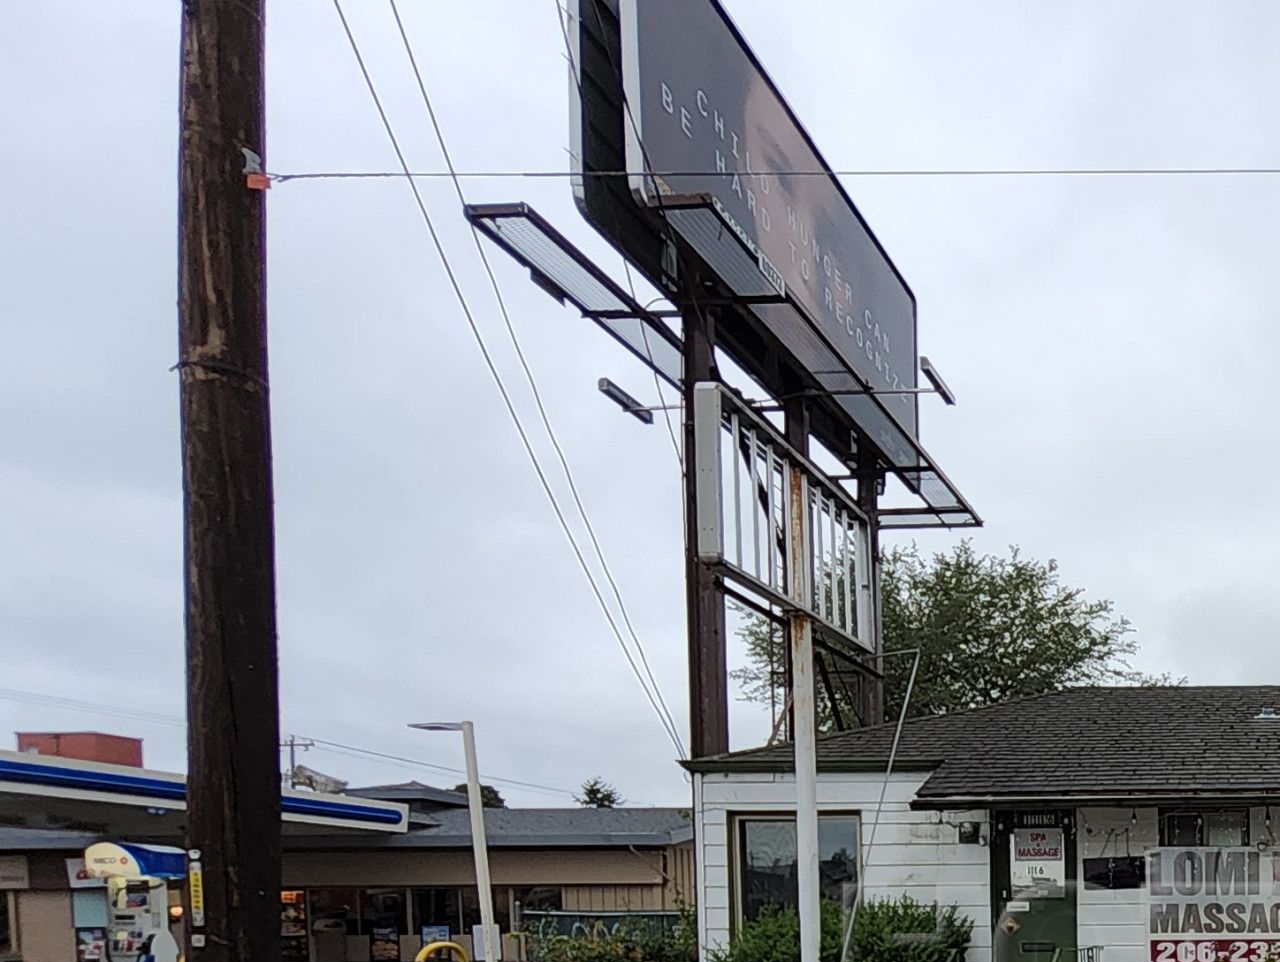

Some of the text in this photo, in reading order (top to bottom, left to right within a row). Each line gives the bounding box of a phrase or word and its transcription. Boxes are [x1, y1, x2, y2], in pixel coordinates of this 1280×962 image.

[661, 82, 693, 138] BE
[716, 150, 771, 232] HARD
[788, 242, 811, 283] TO
[697, 89, 890, 354] CHILD HUNGER CAN
[1018, 847, 1060, 858] MASSAGE
[1029, 832, 1047, 843] SPA
[1149, 850, 1260, 897] LOMI
